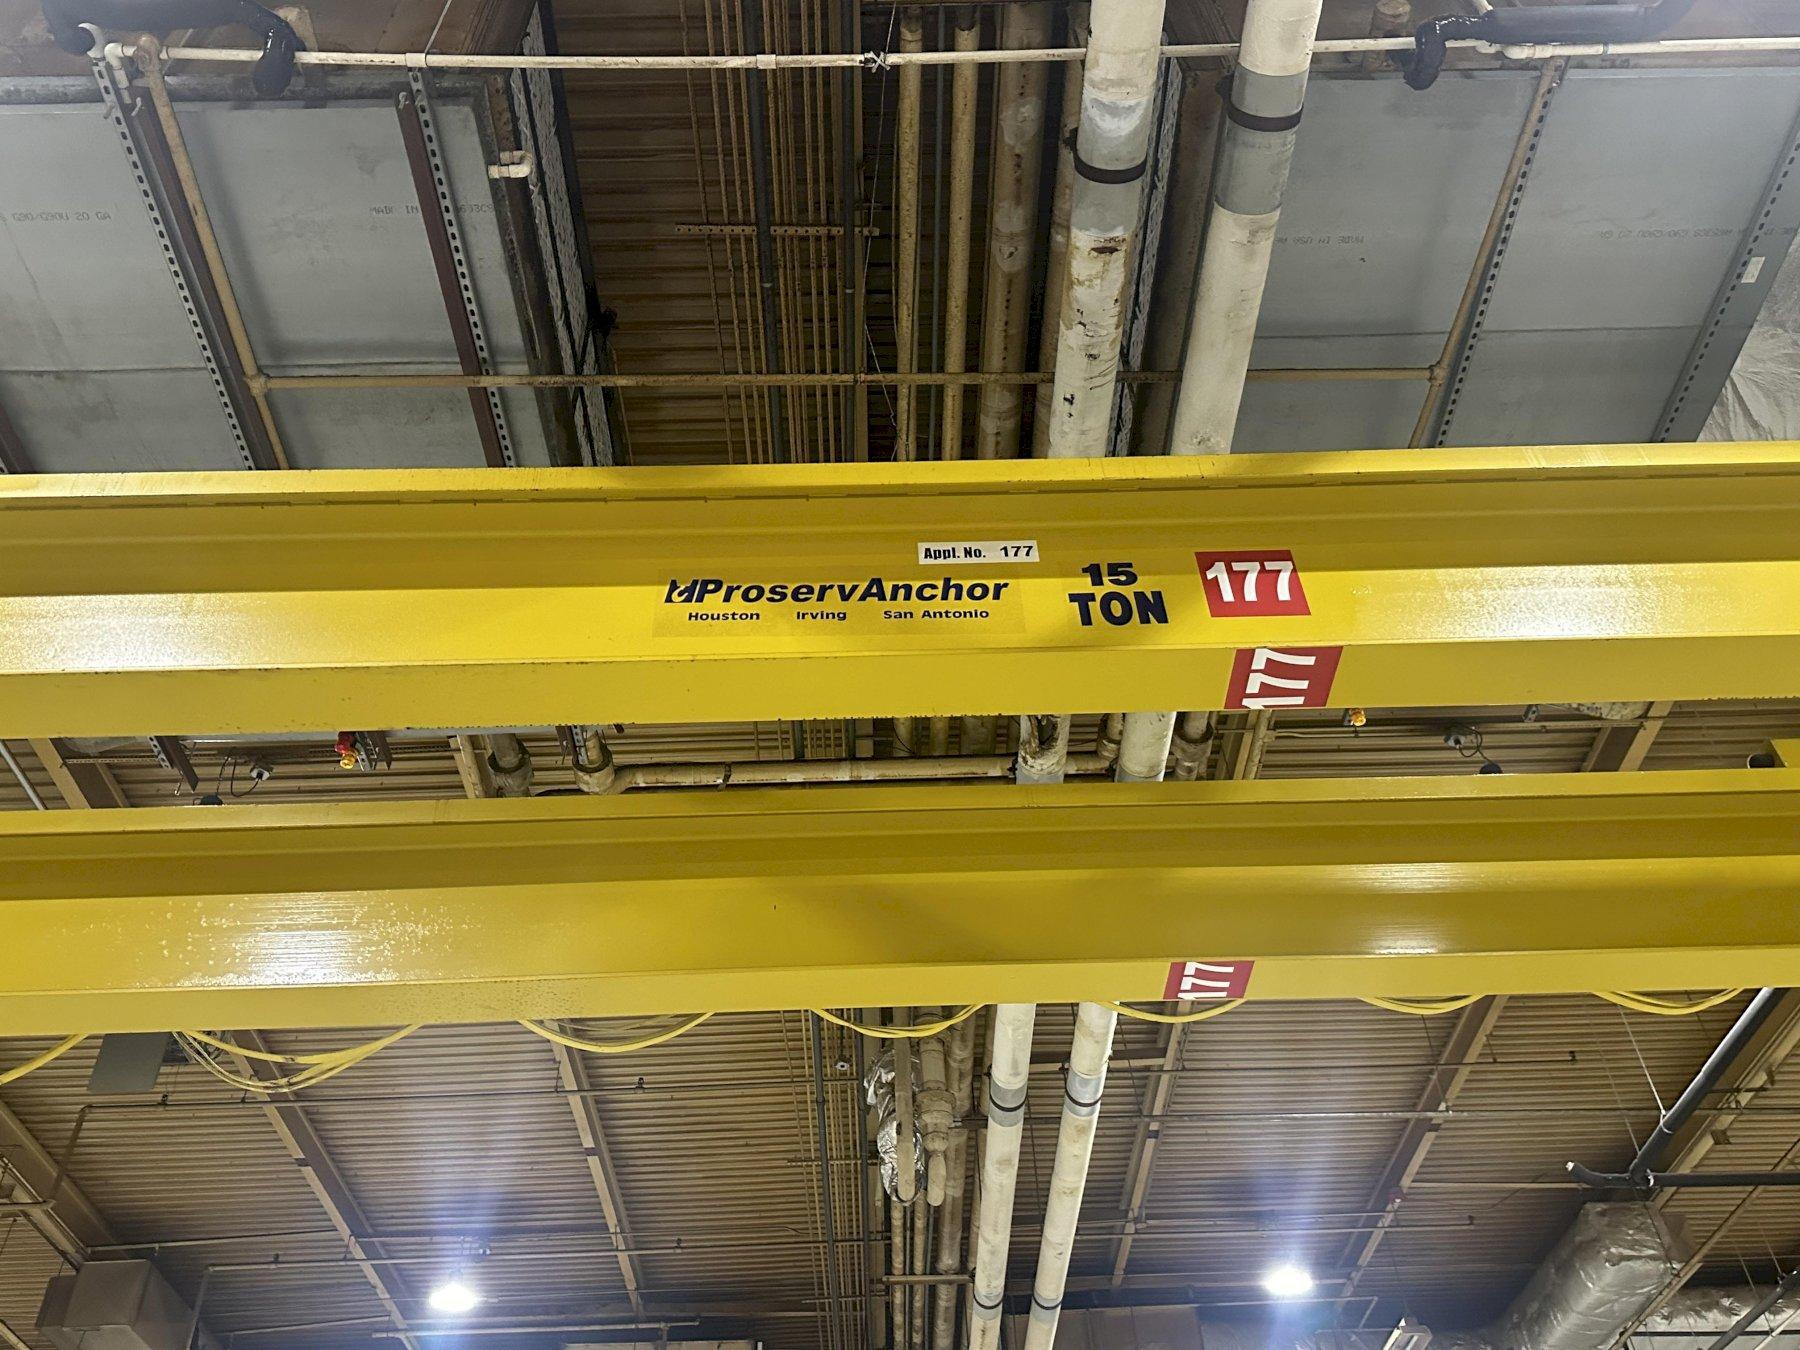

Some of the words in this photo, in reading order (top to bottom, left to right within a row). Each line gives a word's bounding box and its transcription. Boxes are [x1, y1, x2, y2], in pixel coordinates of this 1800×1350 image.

[923, 546, 960, 561] Appl.
[963, 546, 986, 559] No.
[999, 545, 1033, 558] 177
[695, 577, 1010, 603] ProservAnchor
[1081, 562, 1138, 587] 15
[1205, 561, 1294, 603] 177
[688, 611, 760, 621] Houston
[796, 610, 848, 621] Irving
[883, 610, 914, 619] San
[921, 609, 989, 619] Antonio
[1068, 590, 1169, 626] TON
[1241, 648, 1316, 710] 177
[1177, 961, 1235, 1000] 177
